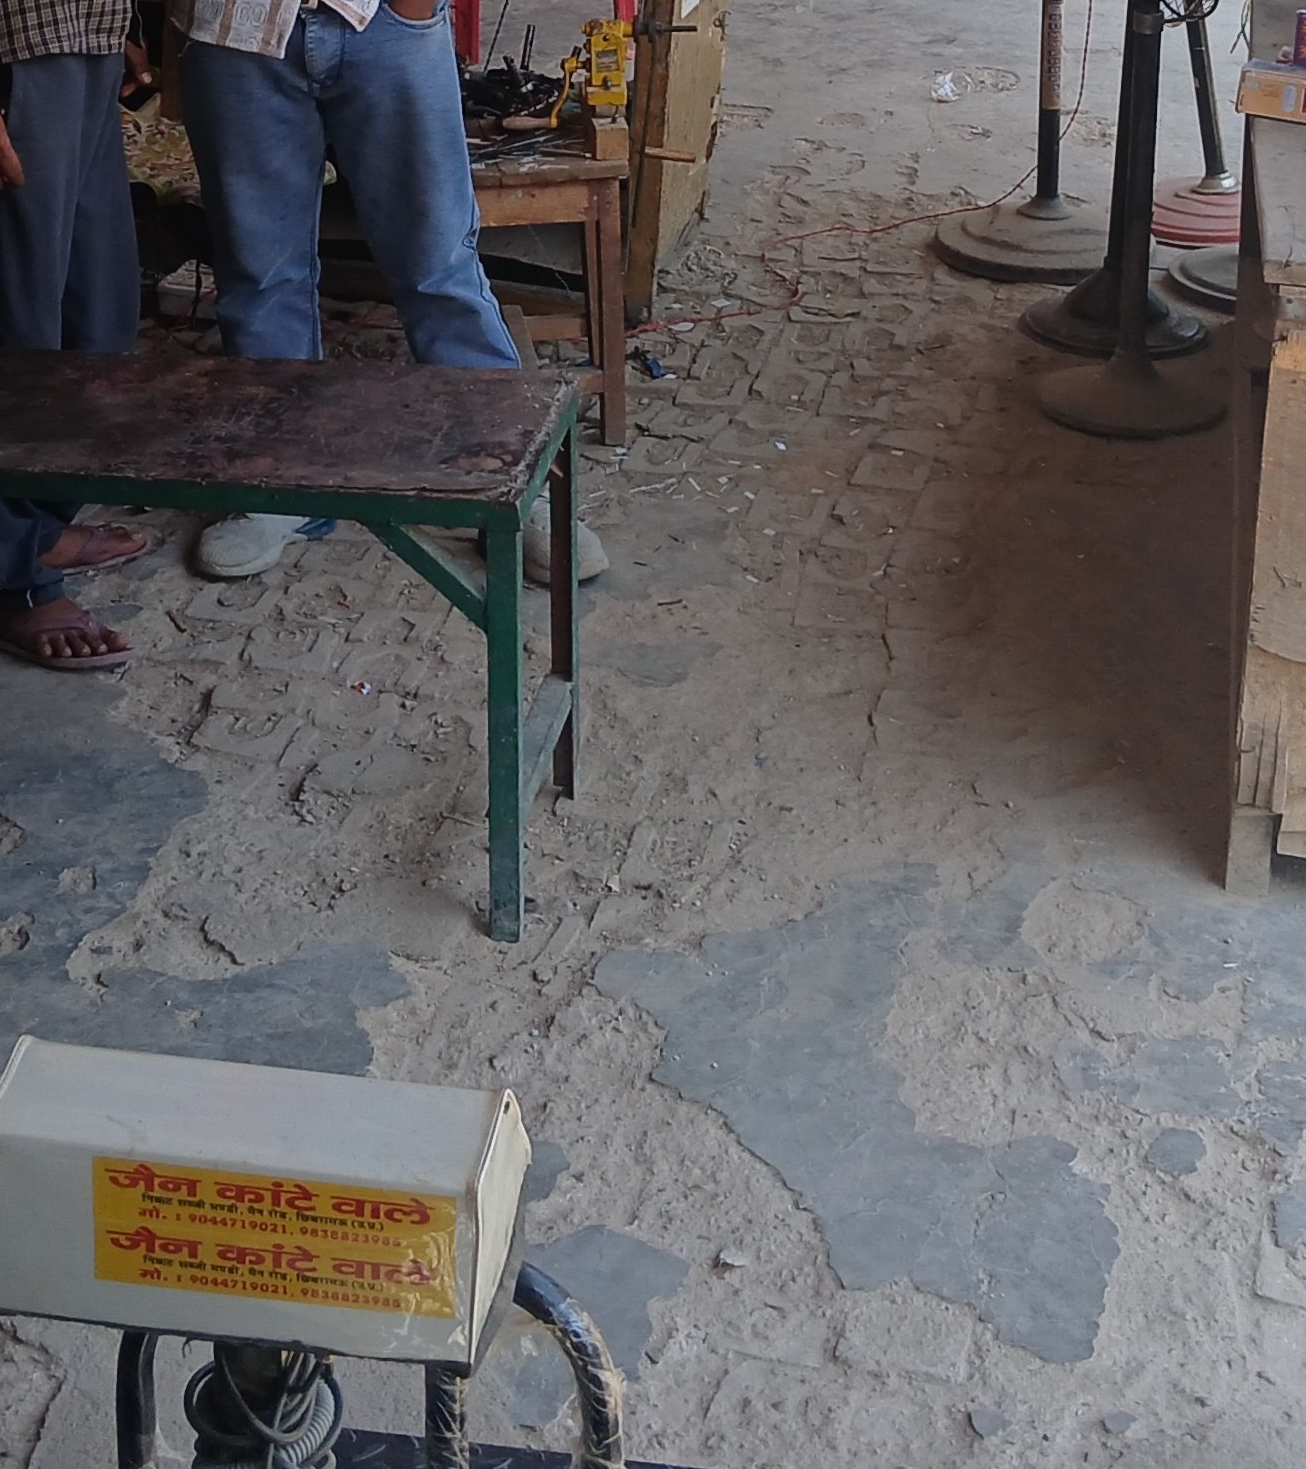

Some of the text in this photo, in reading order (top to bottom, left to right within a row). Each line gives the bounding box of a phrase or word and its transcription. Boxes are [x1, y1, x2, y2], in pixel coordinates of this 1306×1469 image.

[105, 1163, 436, 1225] जैन कांटे वाले
[106, 1225, 431, 1287] जैन कांटे वाले
